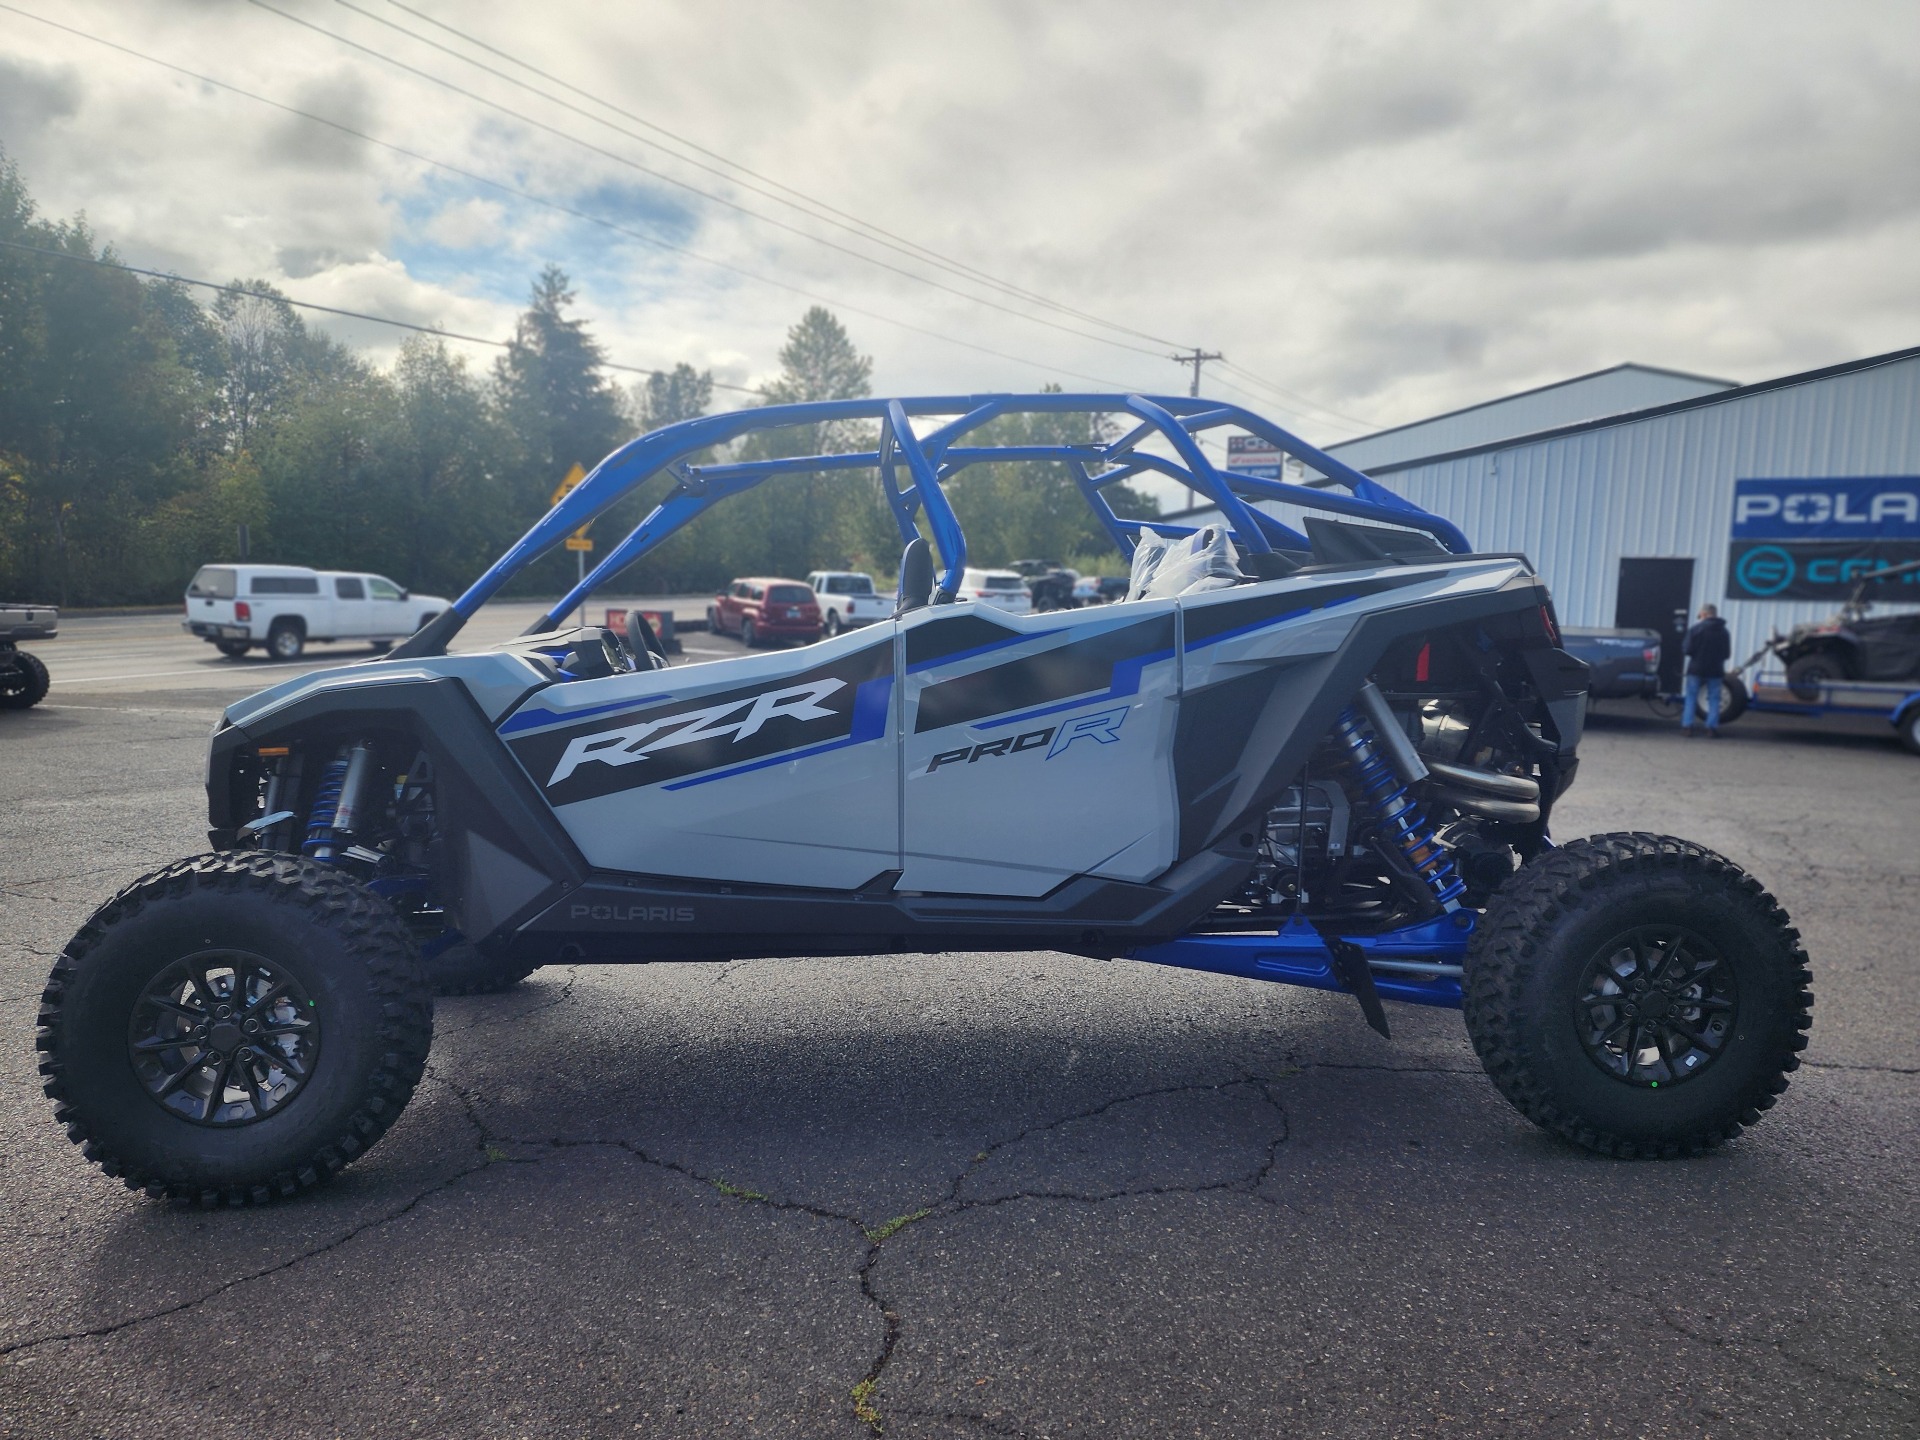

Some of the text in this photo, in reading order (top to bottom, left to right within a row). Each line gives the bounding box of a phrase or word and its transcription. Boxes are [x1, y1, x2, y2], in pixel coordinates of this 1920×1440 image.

[1735, 493, 1919, 523] POLA
[546, 678, 848, 788] RZR
[926, 727, 1056, 774] PRO
[571, 905, 695, 922] POLARIS
